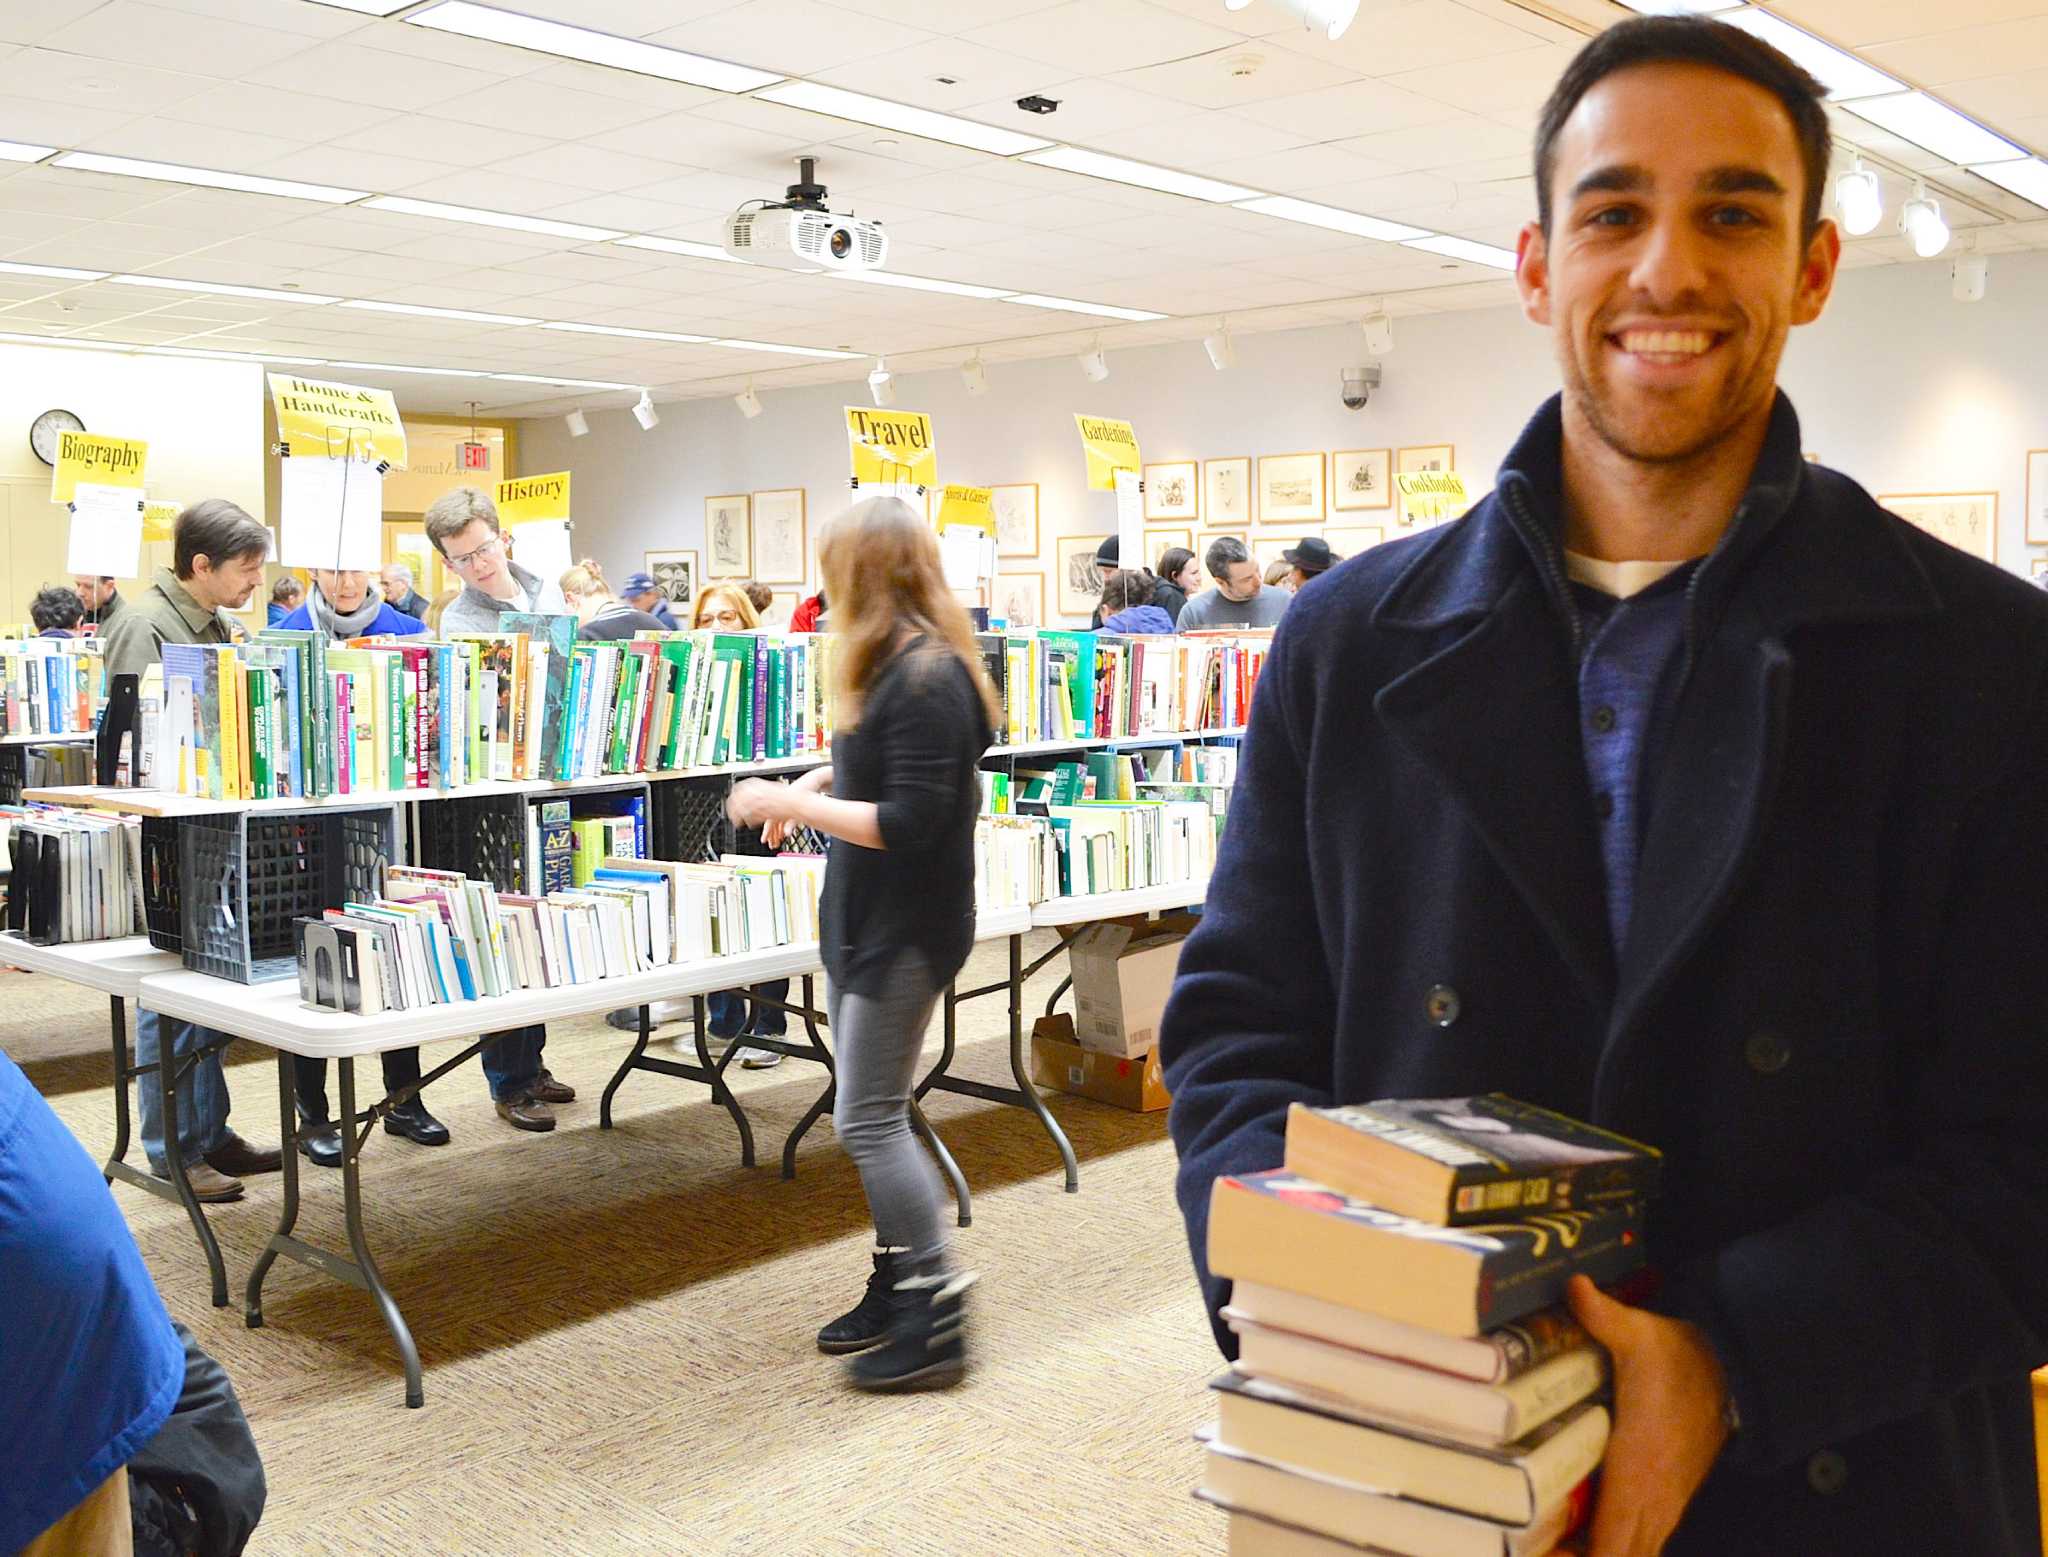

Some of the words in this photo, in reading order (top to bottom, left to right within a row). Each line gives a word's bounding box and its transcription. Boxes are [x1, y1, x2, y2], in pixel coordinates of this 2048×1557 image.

[291, 379, 350, 399] Home
[357, 391, 374, 404] &
[282, 396, 394, 425] Handcrafts
[851, 410, 929, 449] Travel
[1081, 418, 1137, 450] Gardening
[61, 433, 143, 474] Biography
[465, 447, 488, 469] EXIT
[498, 478, 564, 504] History
[392, 702, 401, 733] Garden
[338, 738, 346, 769] Gardens
[393, 735, 401, 757] Book
